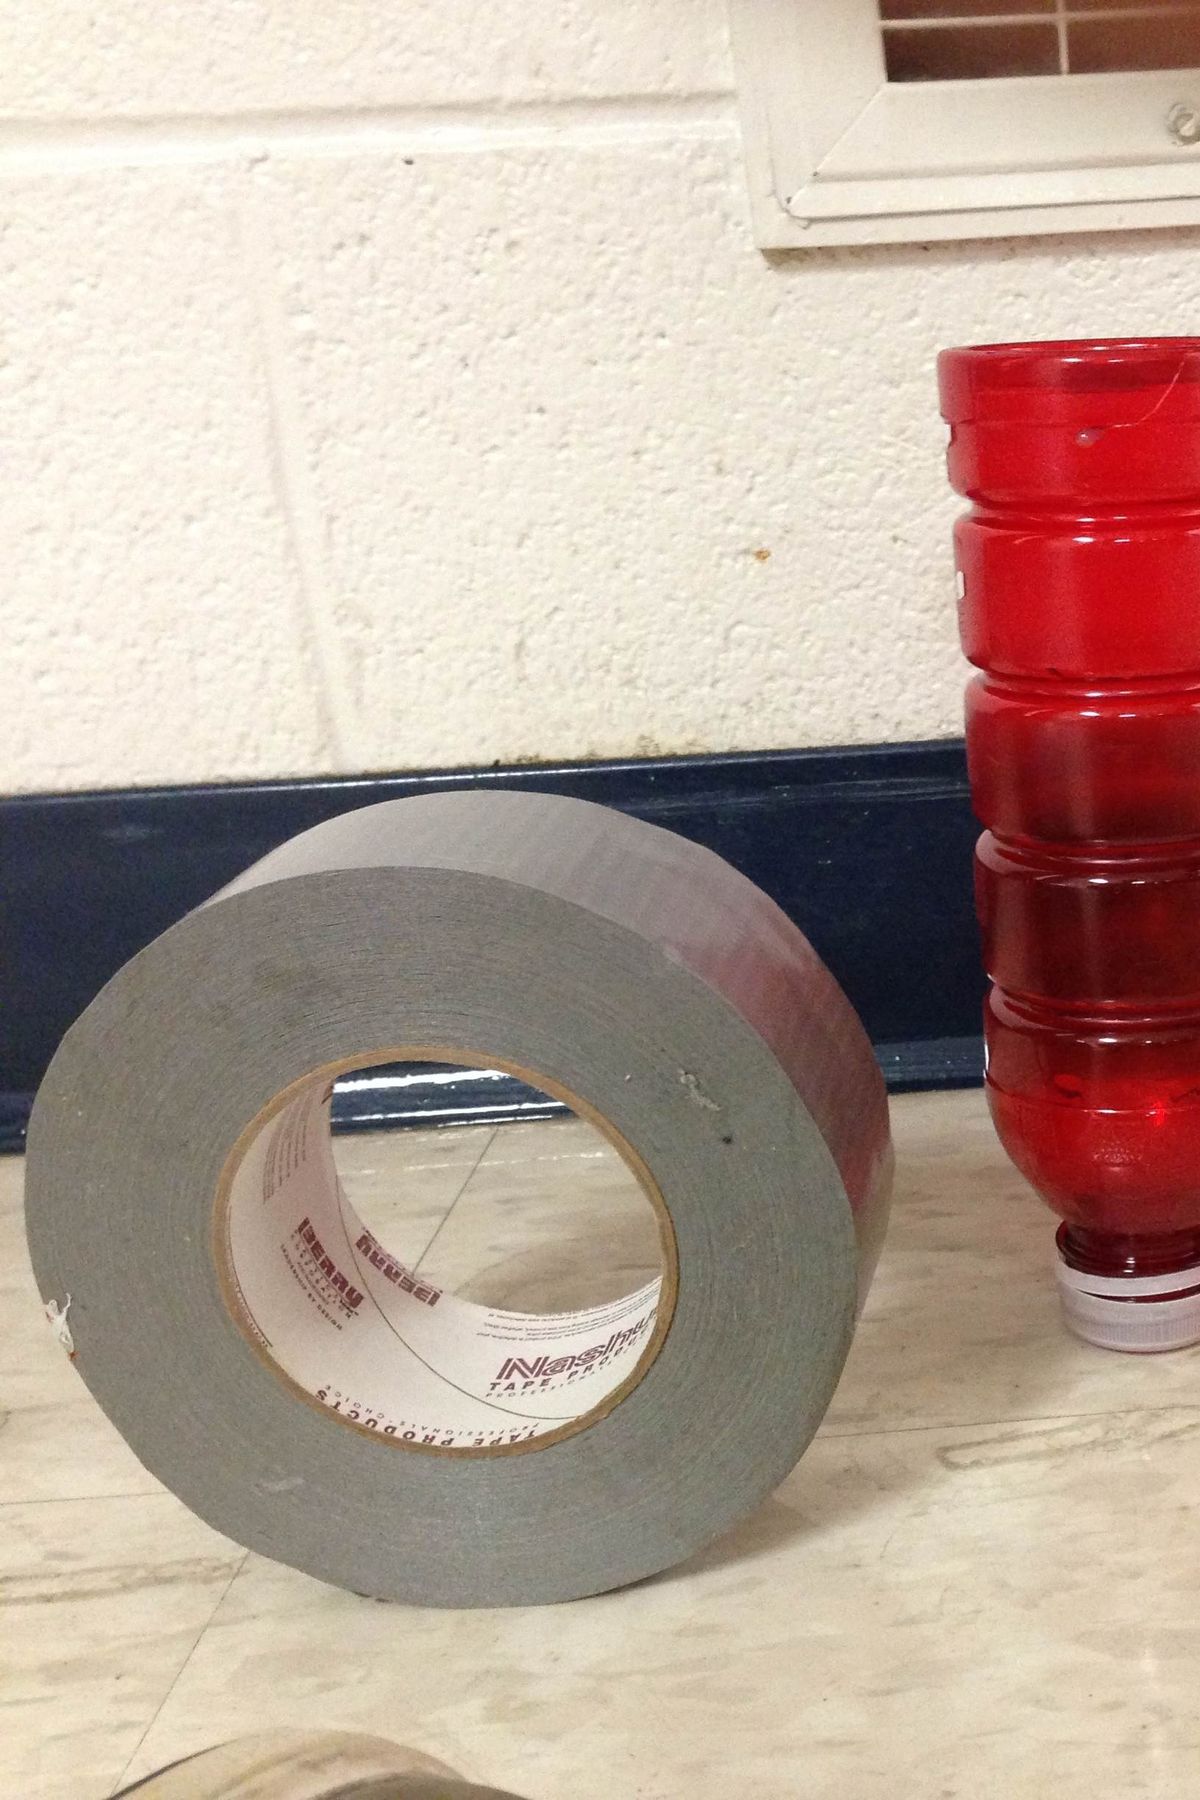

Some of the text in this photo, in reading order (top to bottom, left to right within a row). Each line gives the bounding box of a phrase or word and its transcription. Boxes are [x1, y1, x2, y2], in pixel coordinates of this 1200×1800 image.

[325, 1384, 385, 1419] CHOICE
[489, 1377, 552, 1392] TAPE
[315, 1389, 535, 1448] TAPE PRODUCTS
